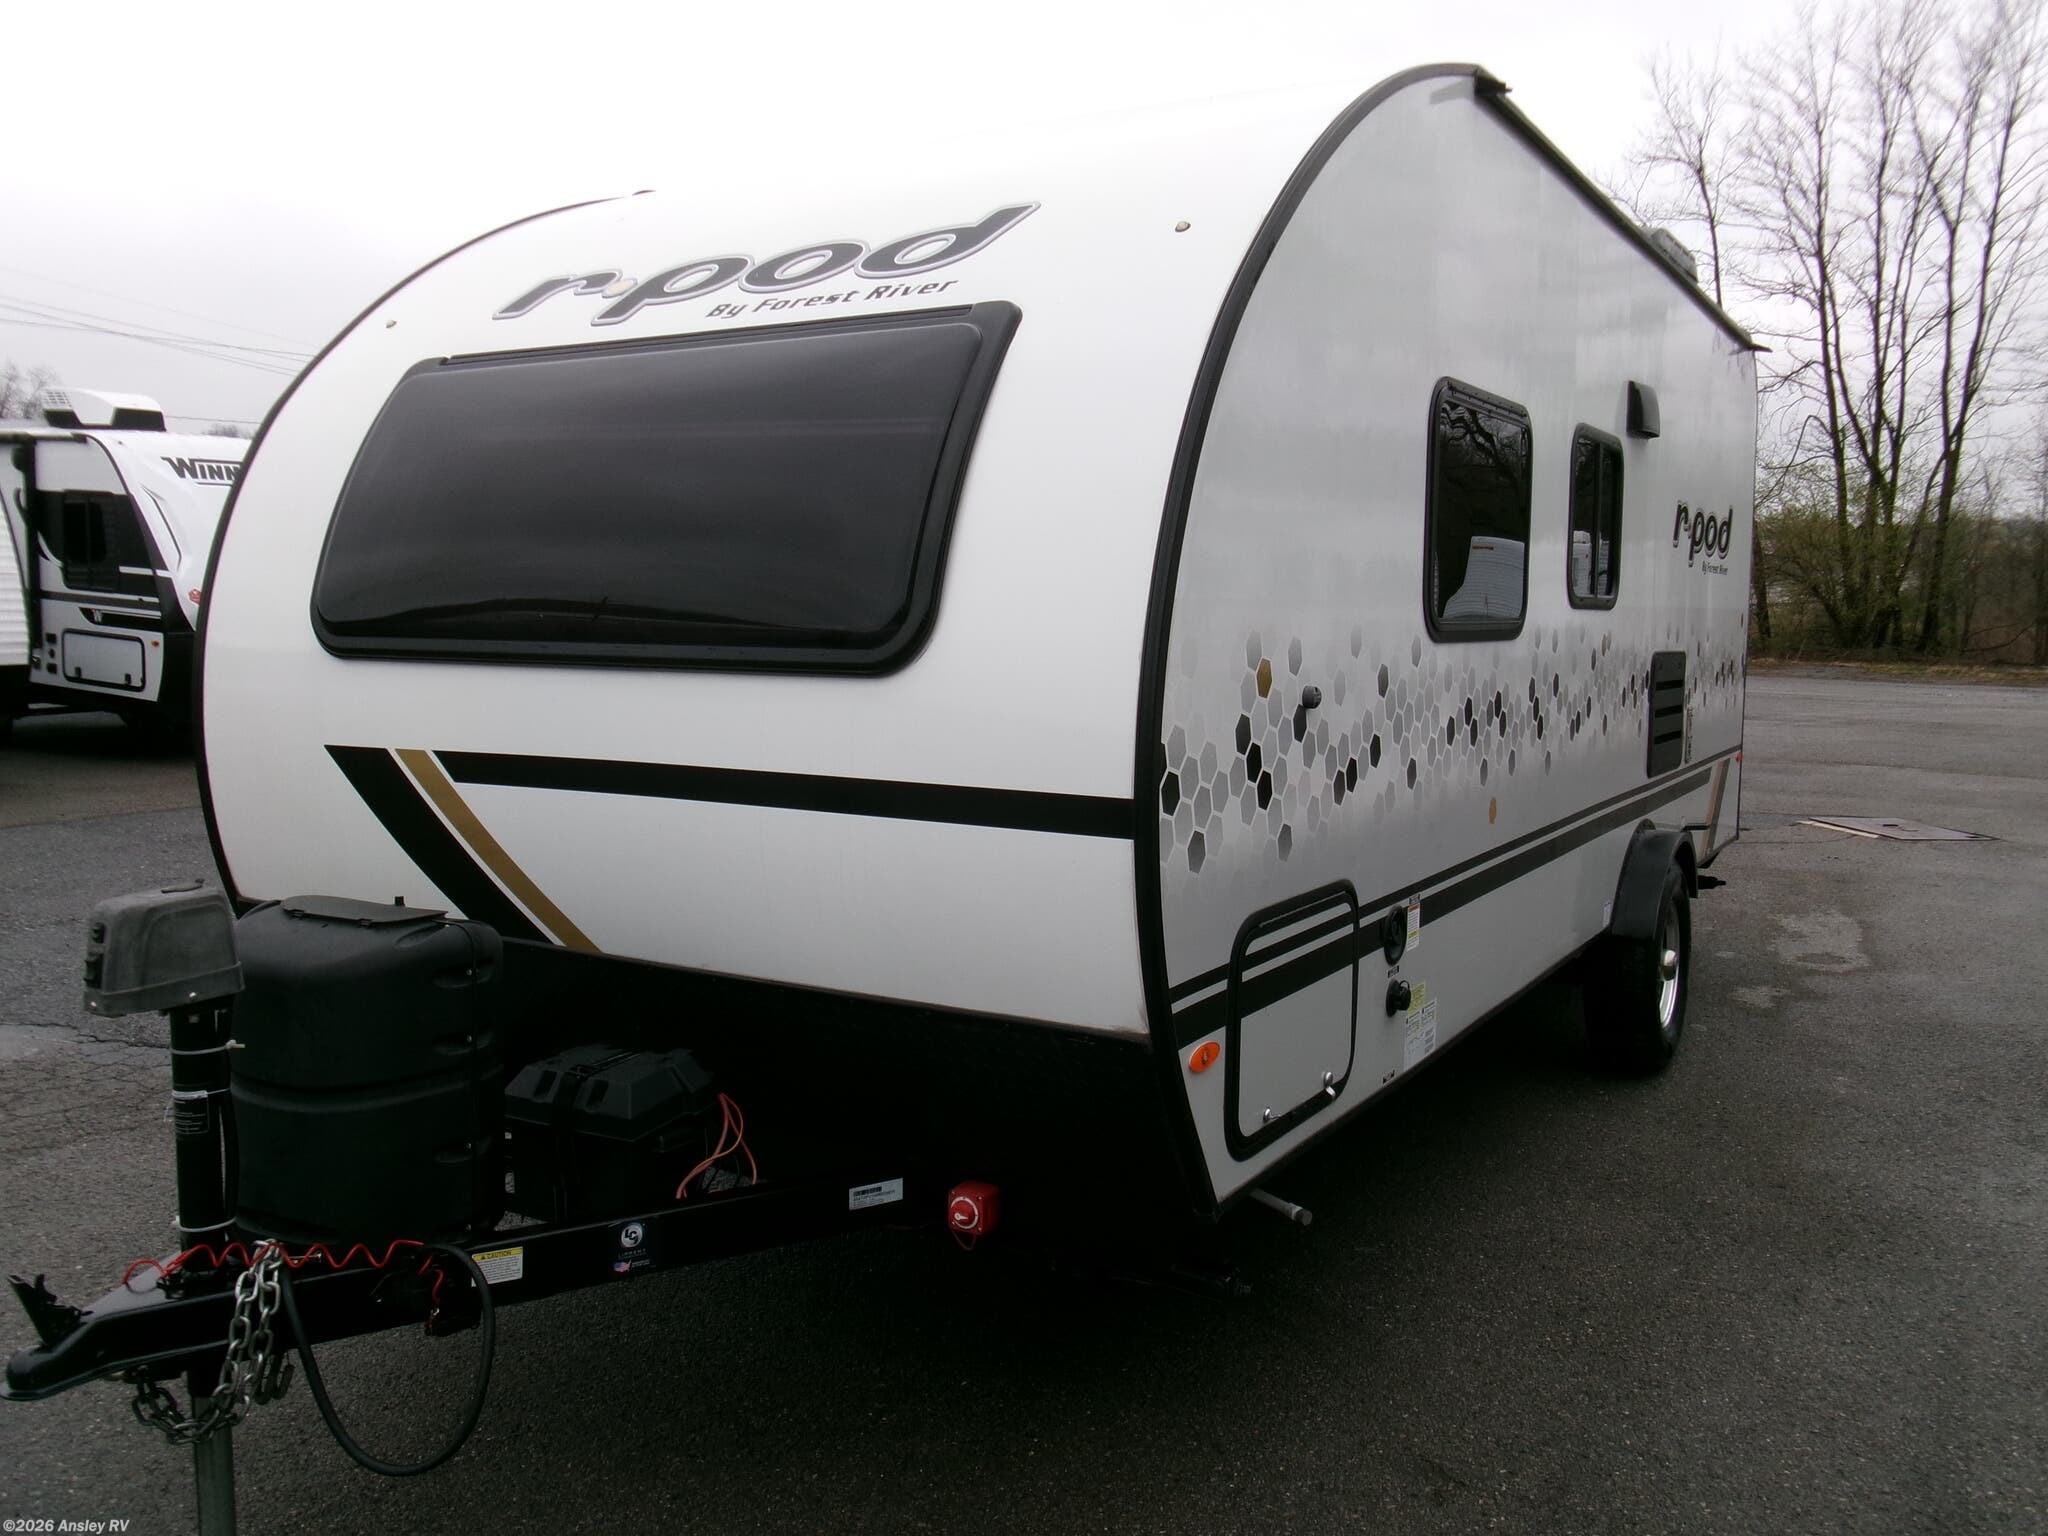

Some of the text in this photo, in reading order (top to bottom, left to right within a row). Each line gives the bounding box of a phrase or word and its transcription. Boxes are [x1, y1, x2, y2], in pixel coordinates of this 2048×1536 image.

[706, 280, 959, 319] By Forest River
[486, 1250, 512, 1260] CAUTION
